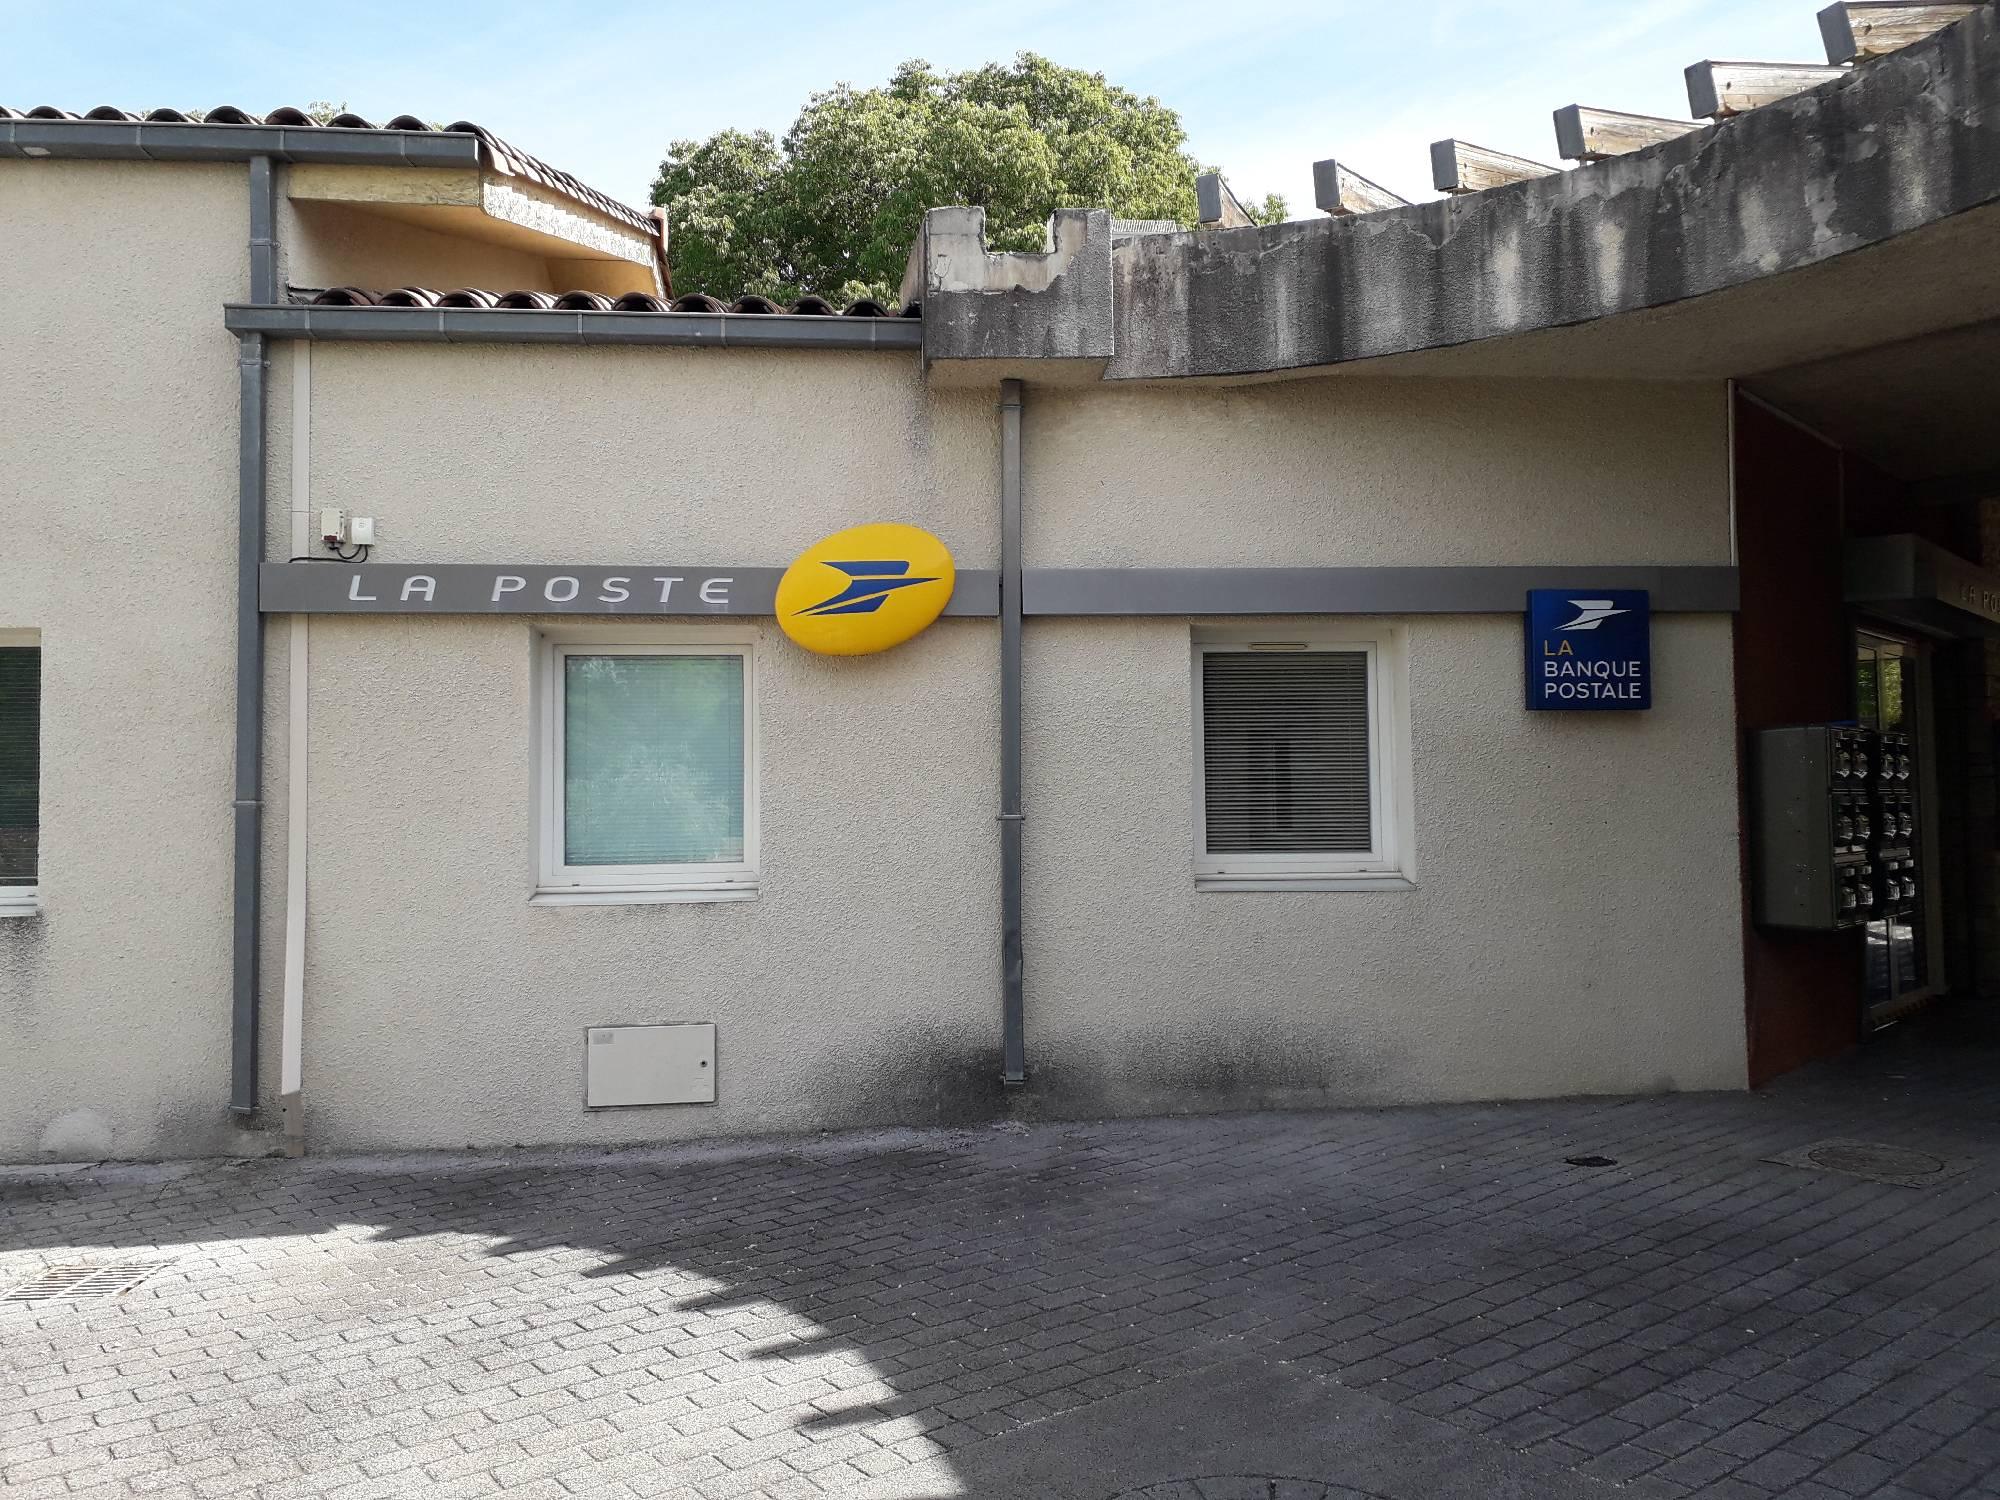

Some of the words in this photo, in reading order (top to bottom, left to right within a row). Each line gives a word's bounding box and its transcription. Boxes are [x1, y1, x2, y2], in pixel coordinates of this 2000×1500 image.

[348, 575, 437, 602] LA
[491, 575, 734, 604] POSTE
[1544, 640, 1573, 656] LA
[1544, 661, 1641, 679] BANQUE
[1544, 682, 1642, 699] POSTALE
